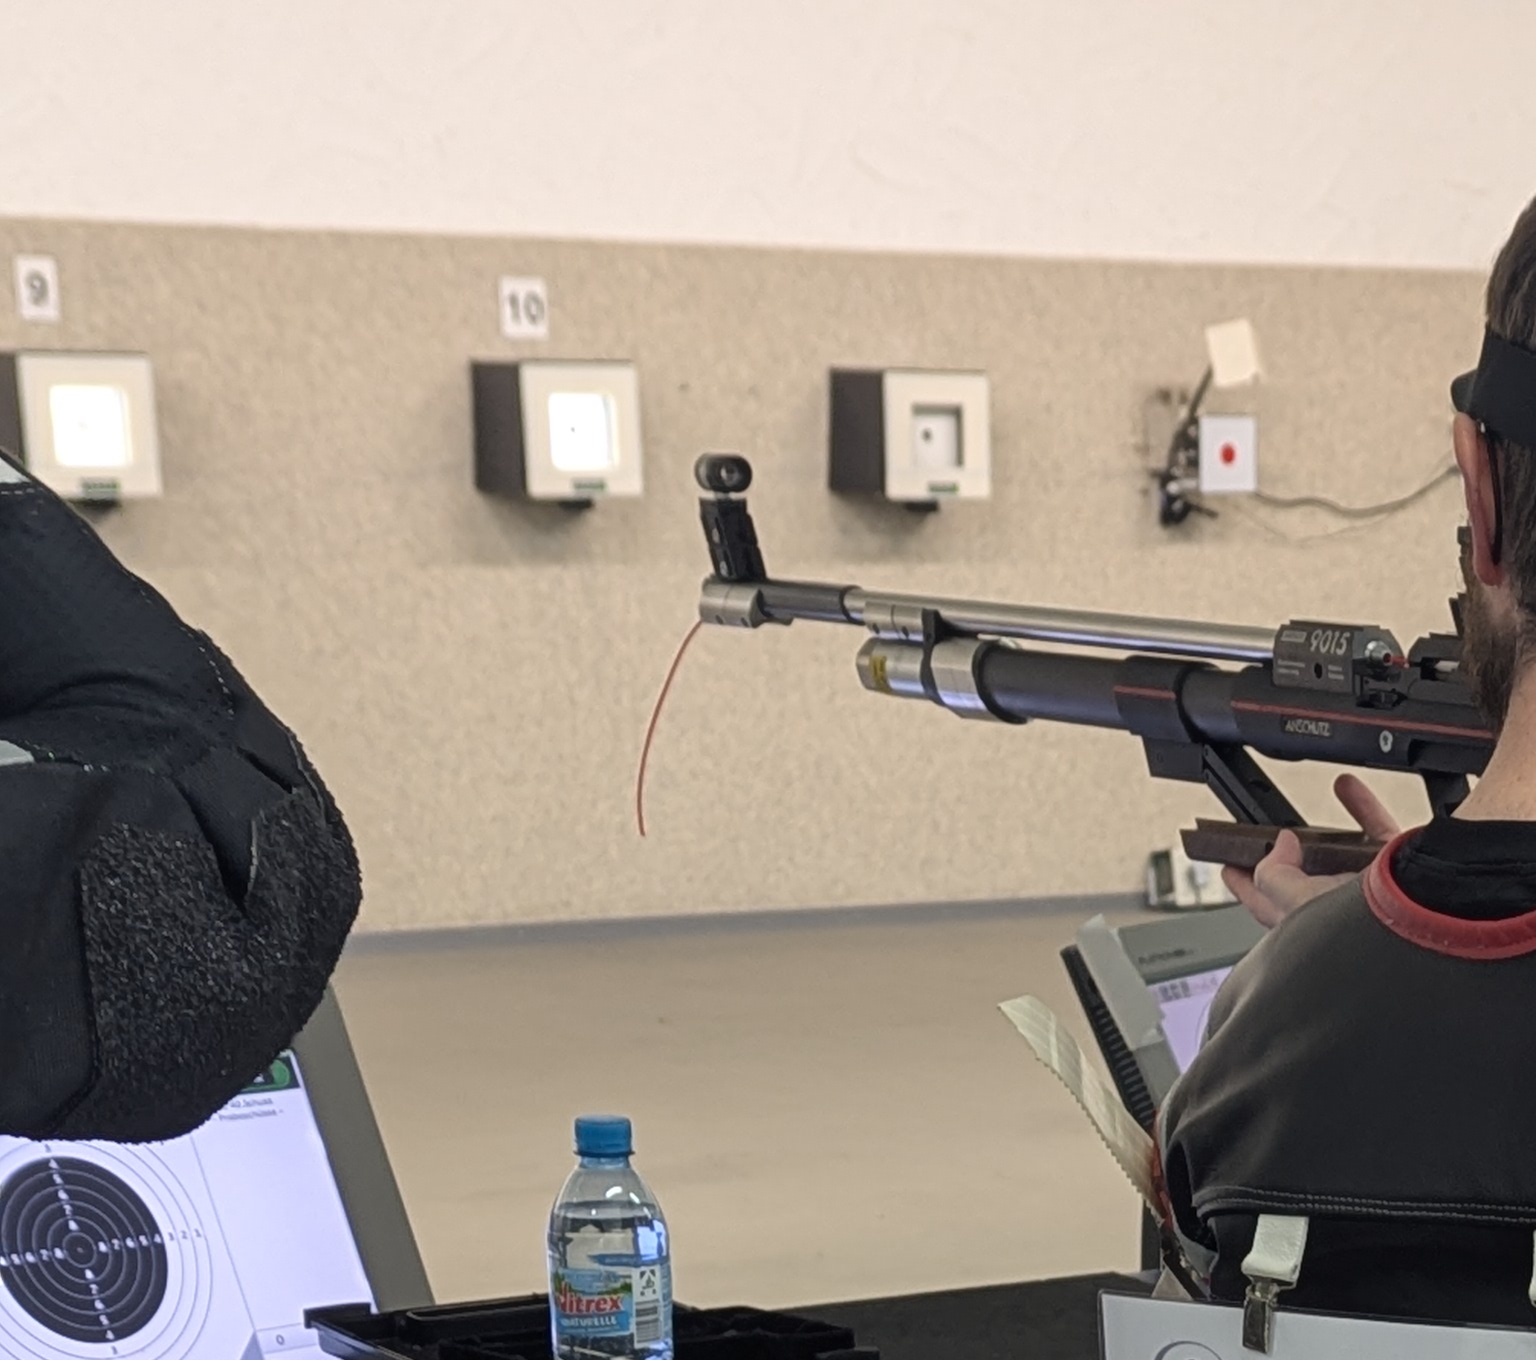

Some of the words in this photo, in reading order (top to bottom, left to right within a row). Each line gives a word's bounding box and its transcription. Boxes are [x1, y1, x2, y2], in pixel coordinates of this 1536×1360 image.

[25, 269, 49, 307] 9
[508, 291, 545, 325] 10
[1310, 629, 1351, 656] 9015
